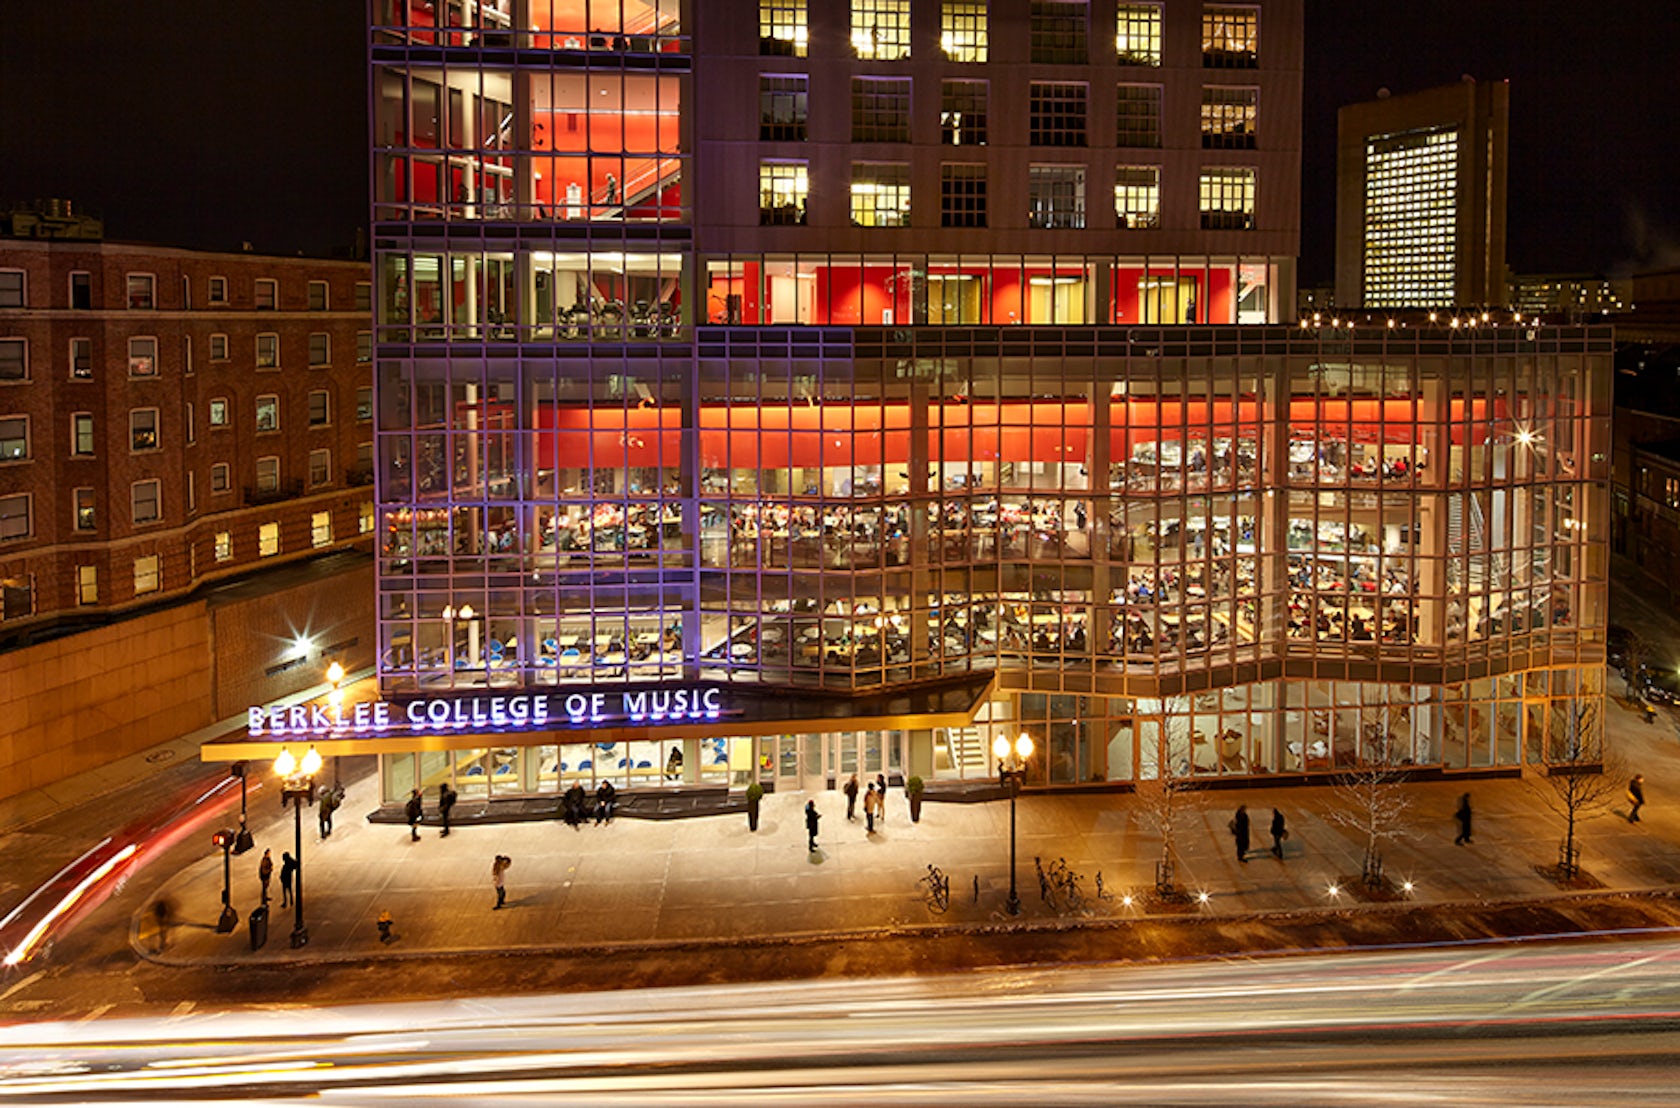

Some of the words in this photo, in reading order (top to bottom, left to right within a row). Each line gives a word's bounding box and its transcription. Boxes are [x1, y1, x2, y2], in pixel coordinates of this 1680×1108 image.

[248, 702, 389, 729] BERKLEE
[407, 695, 548, 723] COLLEGE
[565, 693, 605, 717] OF
[623, 688, 720, 714] MUSIC
